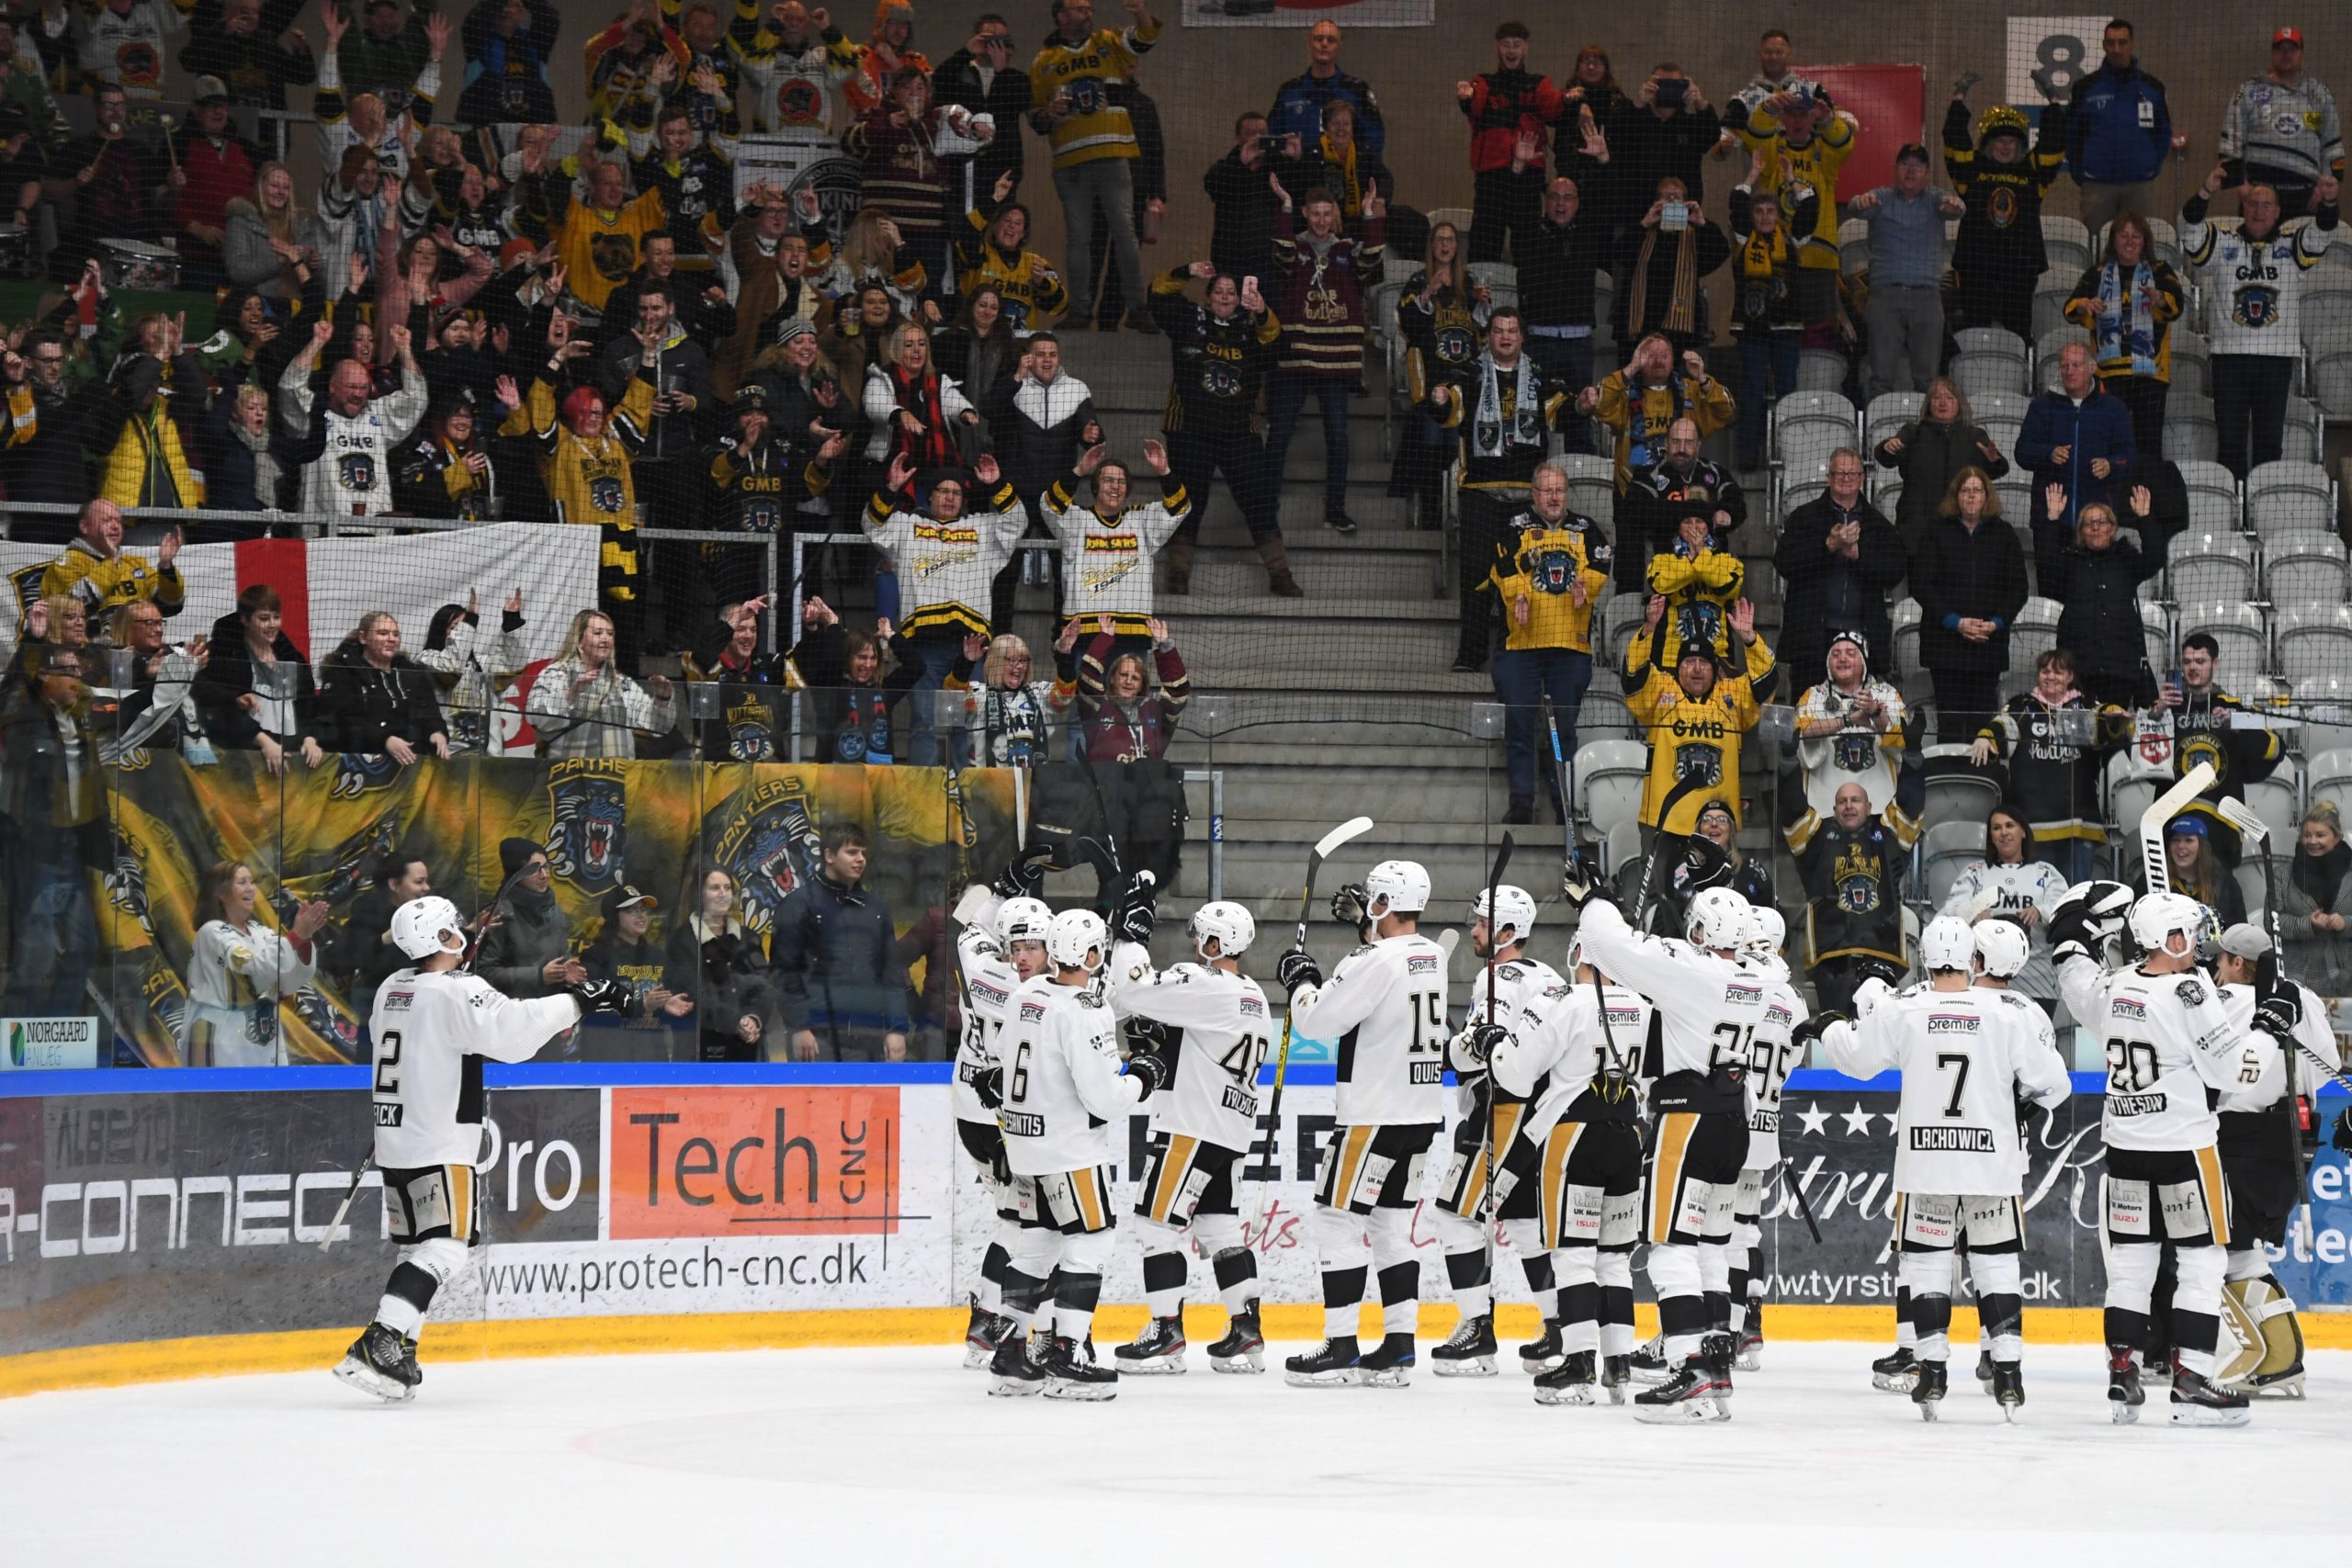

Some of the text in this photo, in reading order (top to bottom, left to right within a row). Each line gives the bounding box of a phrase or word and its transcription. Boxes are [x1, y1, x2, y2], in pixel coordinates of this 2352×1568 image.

[1057, 56, 1101, 75] GMB
[2037, 35, 2085, 101] 8
[2235, 265, 2278, 280] GMB
[741, 477, 781, 492] GMB
[1673, 719, 1724, 739] GMB
[1417, 898, 1425, 908] 15
[1736, 927, 1745, 937] 21
[1052, 939, 1057, 949] 6
[1944, 949, 1951, 959] 7
[1408, 961, 1438, 976] premier
[969, 984, 1009, 1005] premier
[1724, 989, 1763, 1004] premier
[26, 1021, 87, 1043] NØRGAARD
[1408, 990, 1442, 1055] 15
[1928, 1019, 1980, 1034] premier
[374, 1028, 403, 1096] 2
[1011, 1039, 1032, 1105] 6
[2106, 1036, 2163, 1095] 20
[1936, 1052, 1972, 1120] 7
[2109, 1092, 2165, 1115] ATHESON
[1004, 1111, 1043, 1135] ESANTIS
[1914, 1128, 1995, 1151] LACHOWICZ
[629, 1108, 819, 1206] Tech
[840, 1121, 865, 1204] CNC
[2117, 1203, 2143, 1212] Motors
[1914, 1213, 1951, 1225] UK Motors
[1916, 1224, 1948, 1236] ISUZU
[480, 1242, 867, 1303] www.protech-cnc.dk
